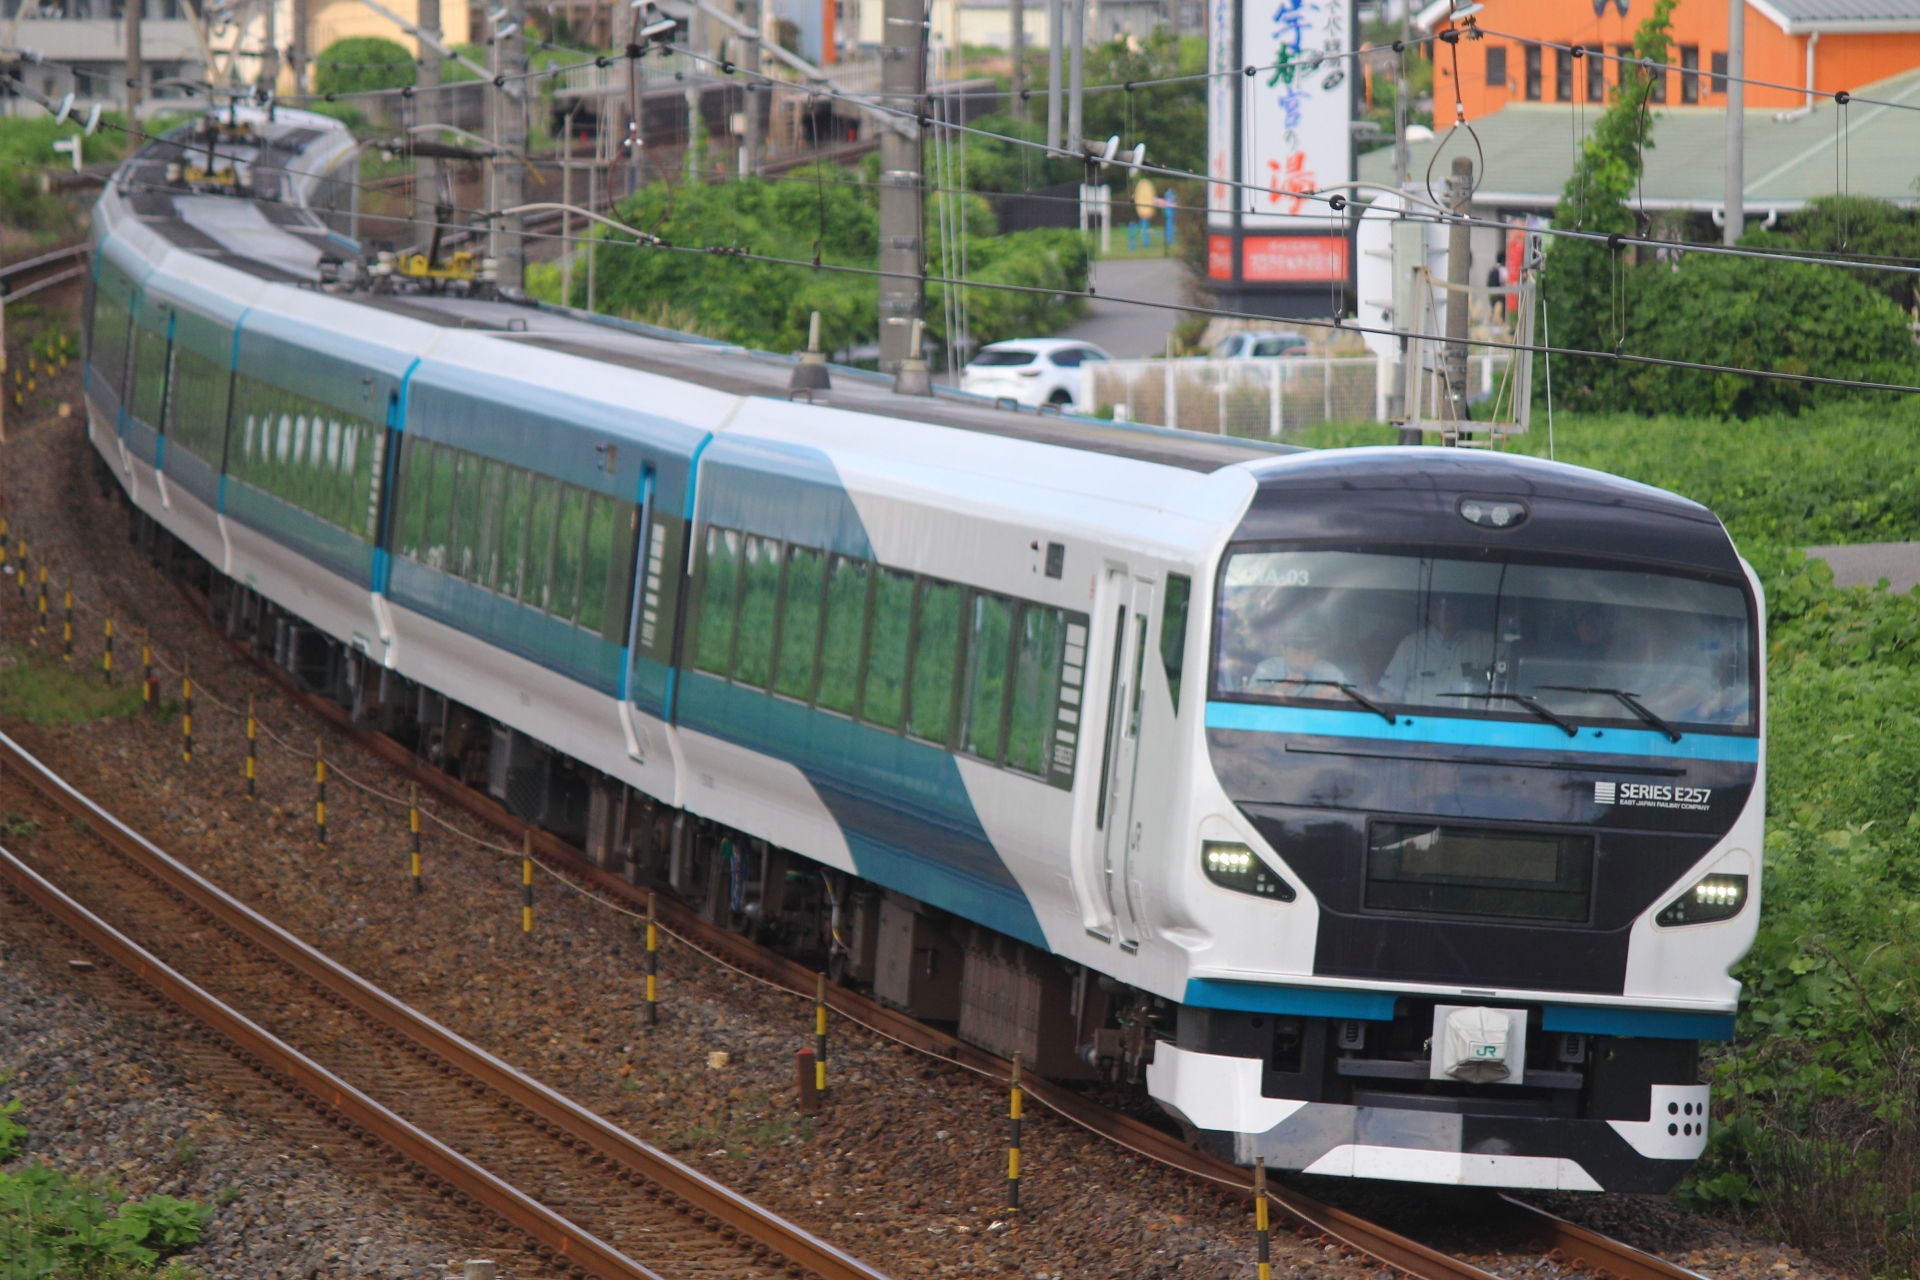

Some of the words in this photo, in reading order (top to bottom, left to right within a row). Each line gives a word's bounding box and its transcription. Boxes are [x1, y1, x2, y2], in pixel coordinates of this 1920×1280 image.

[1620, 783, 1672, 800] SERIES
[1674, 787, 1712, 804] E257
[1476, 1046, 1496, 1057] JR
